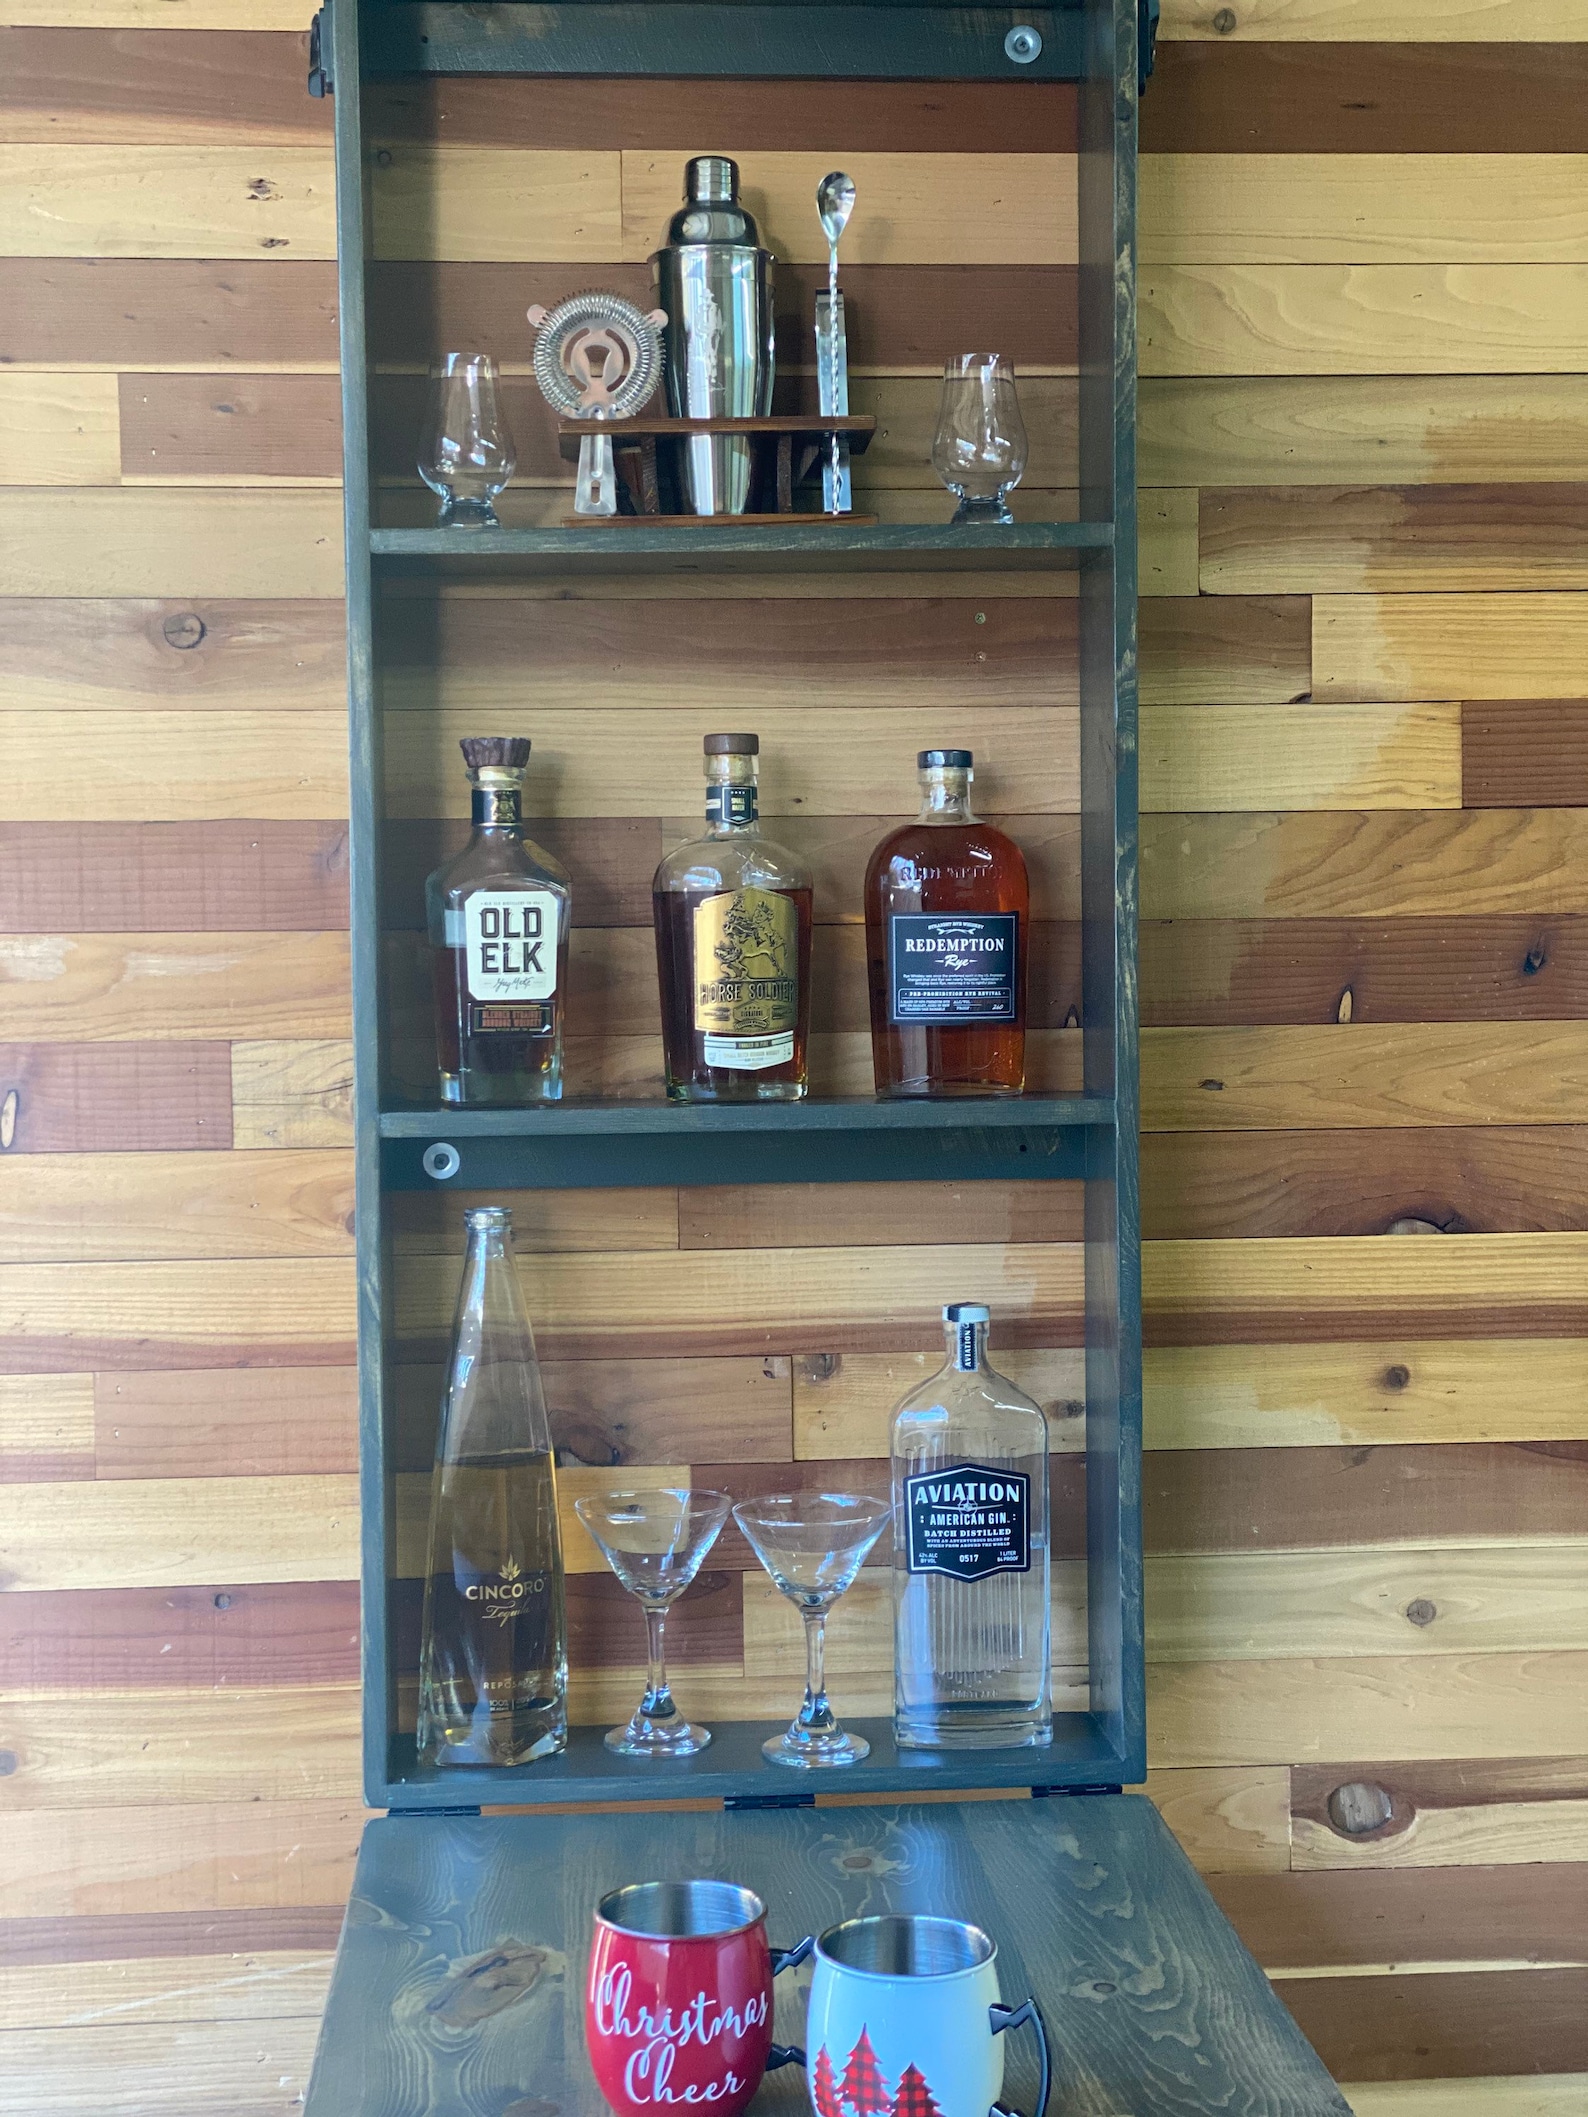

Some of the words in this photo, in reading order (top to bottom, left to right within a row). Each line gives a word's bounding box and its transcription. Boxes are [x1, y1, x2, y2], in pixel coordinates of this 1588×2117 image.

[479, 907, 543, 939] OLD
[905, 938, 1005, 952] REDEMPTION
[479, 941, 545, 974] ELK
[944, 954, 970, 971] Rye
[700, 982, 742, 1006] HORSE
[748, 981, 795, 1002] SOLDIER
[964, 1330, 972, 1367] AVIATION
[915, 1483, 1020, 1505] AVIATION
[930, 1512, 985, 1526] AMERICAN
[960, 1528, 1012, 1537] DISTILLED
[959, 1554, 979, 1562] 0517
[465, 1578, 545, 1600] CINCORO
[482, 1597, 531, 1628] Tequila
[595, 1961, 769, 2047] Christmas
[624, 2036, 746, 2104] Cheer
